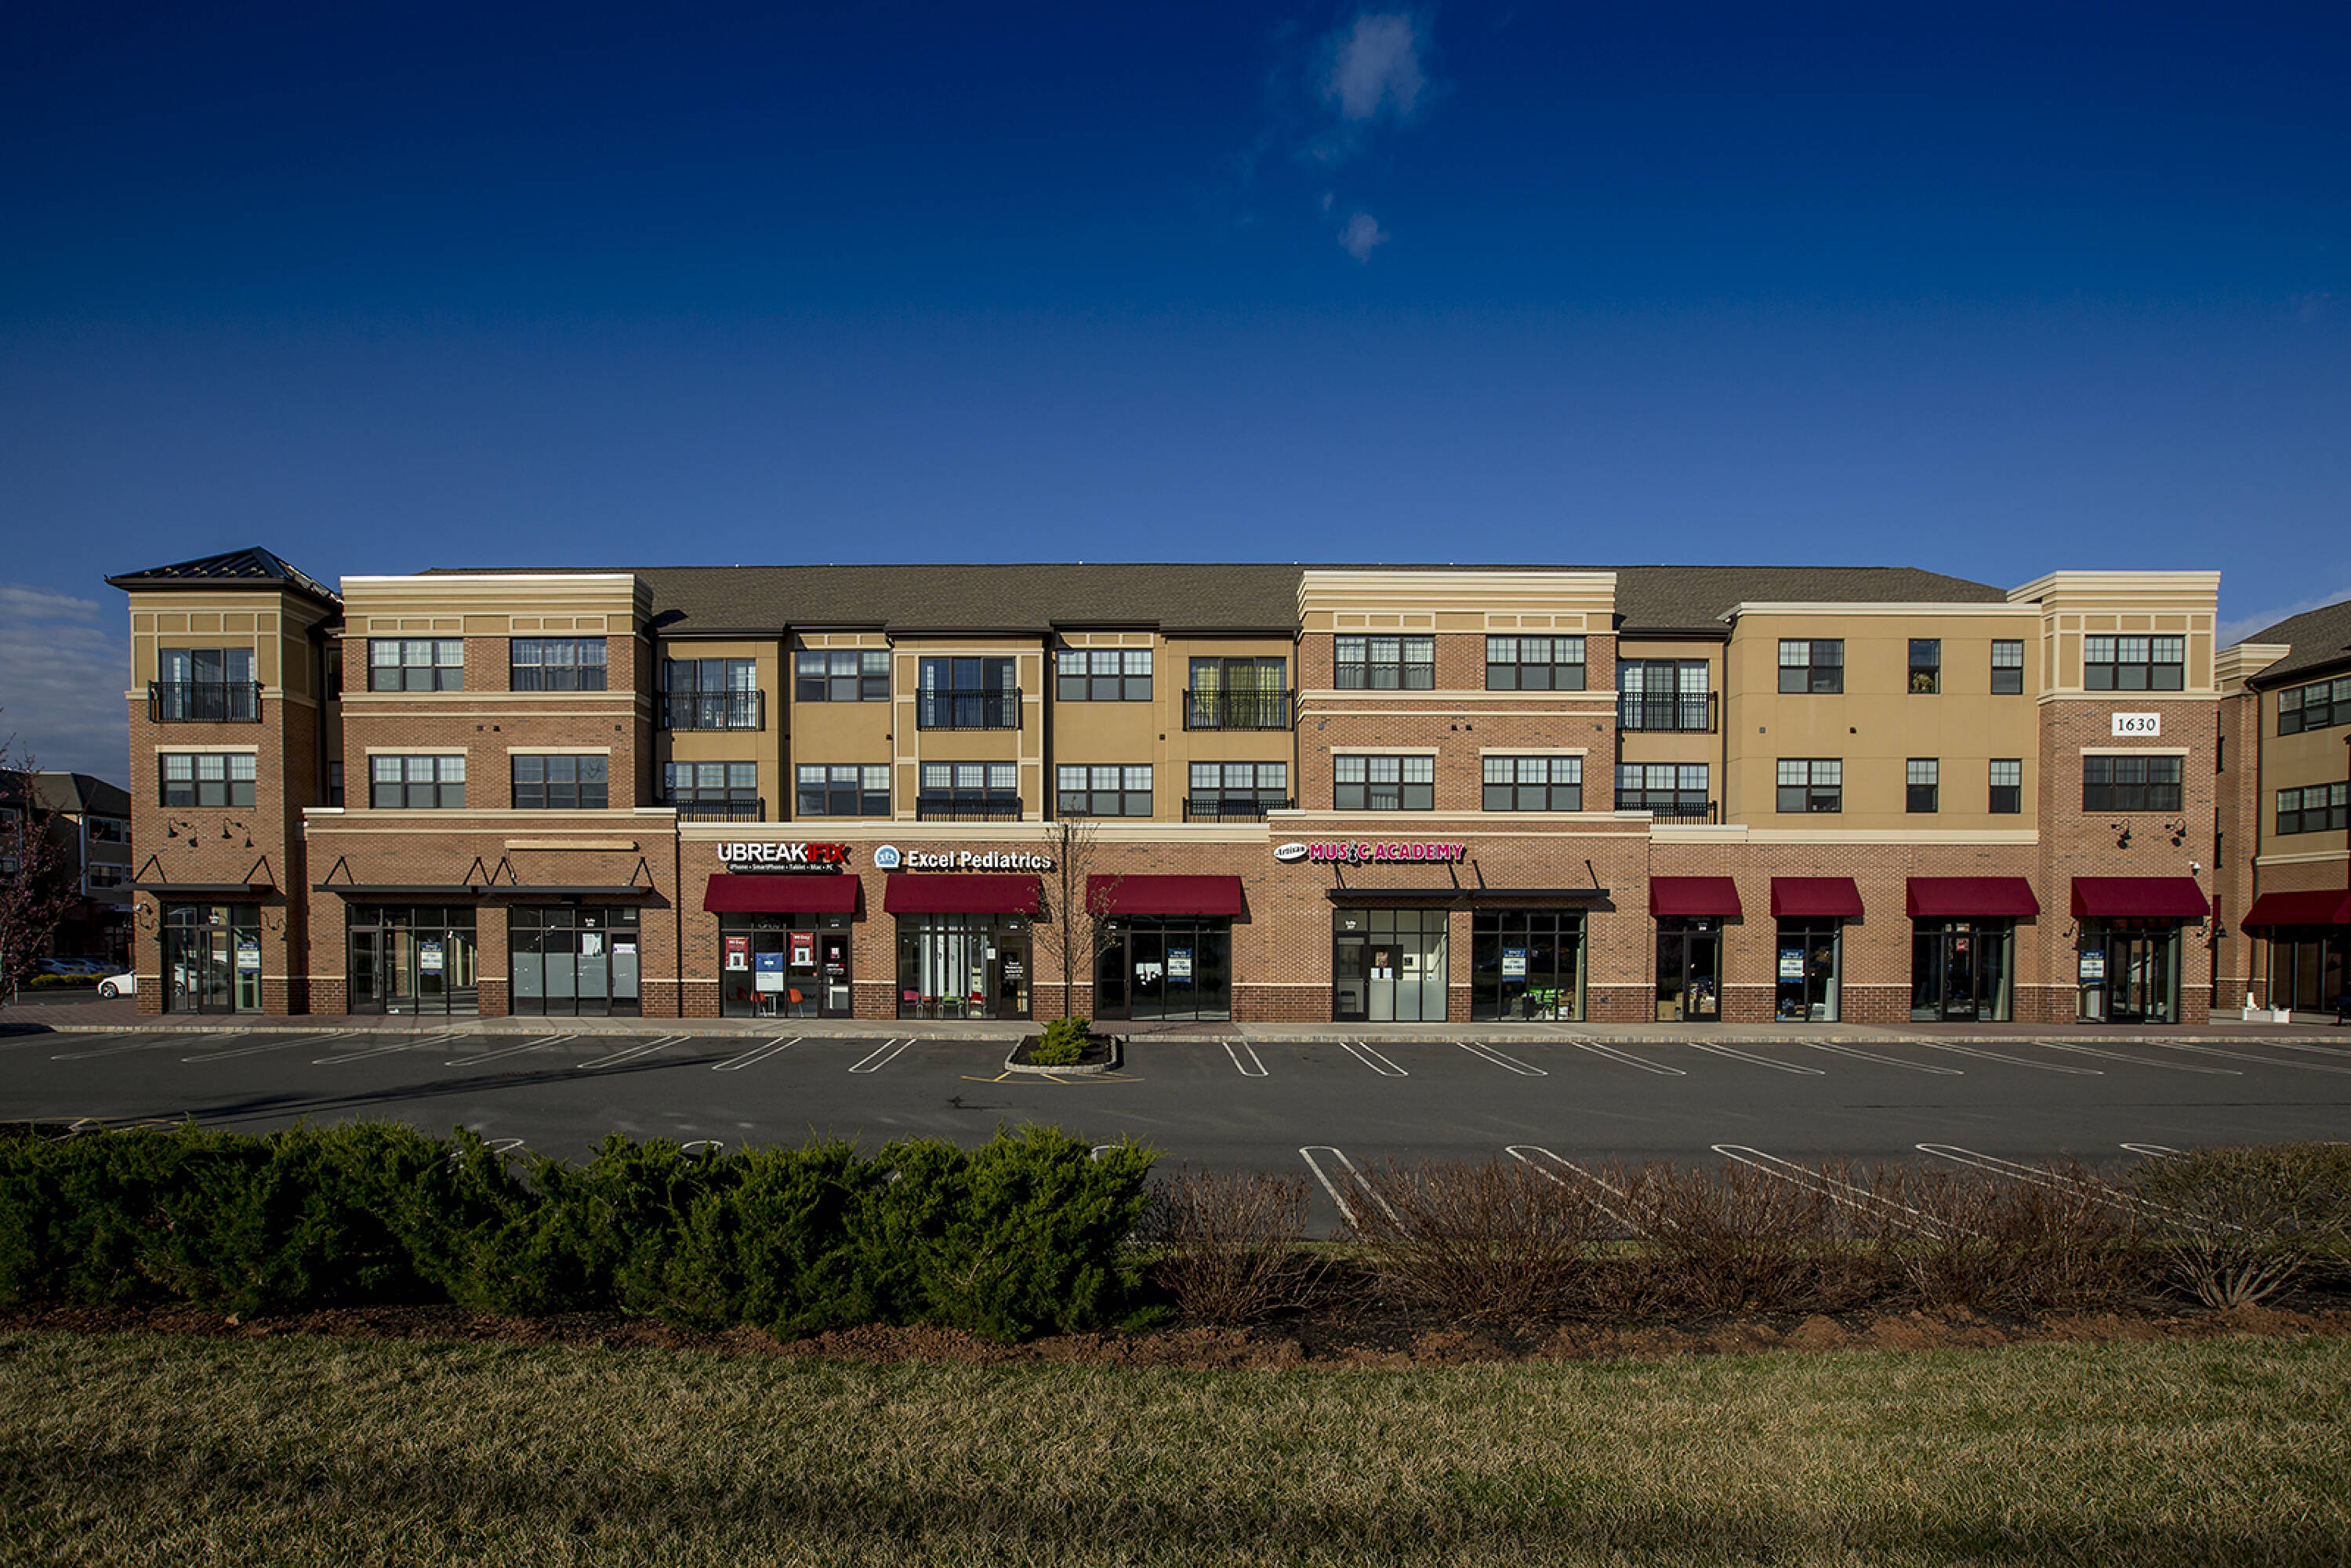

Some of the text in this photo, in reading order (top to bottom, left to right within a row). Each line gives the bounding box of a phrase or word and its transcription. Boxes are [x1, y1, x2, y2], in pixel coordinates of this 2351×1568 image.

[2118, 717, 2157, 731] 1630
[717, 843, 846, 862] UBREAKIFIX
[907, 850, 1052, 869] Excel Pediatrics
[1374, 843, 1464, 861] ACADEMY
